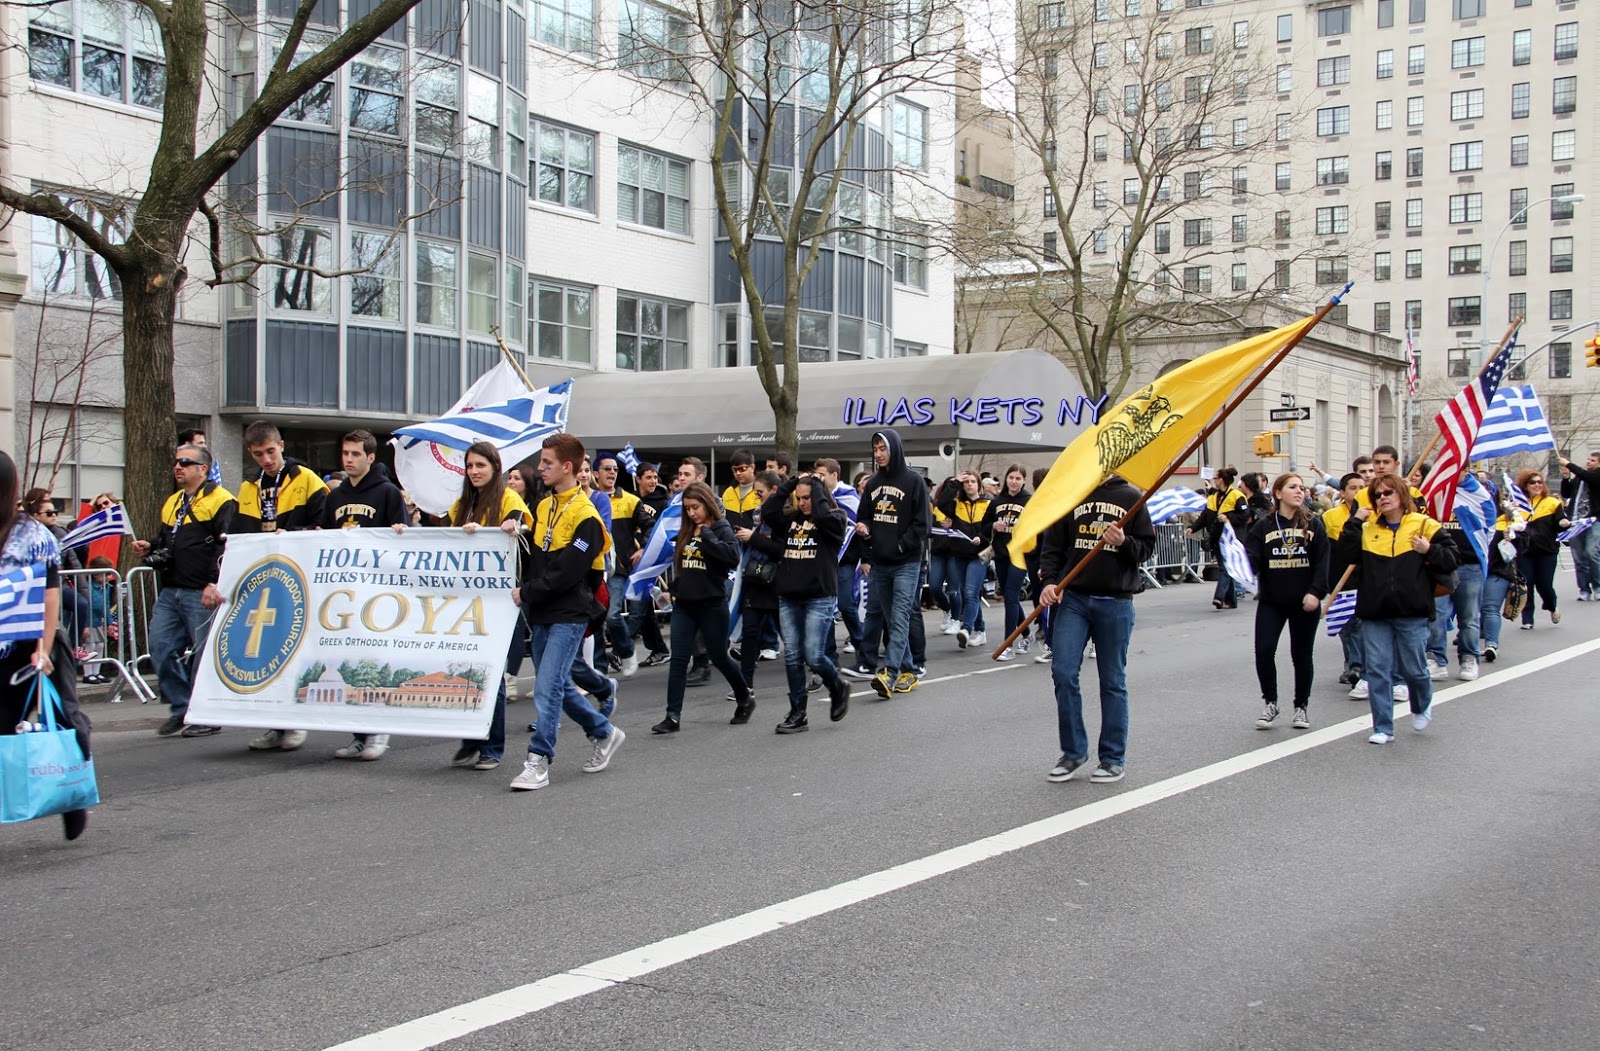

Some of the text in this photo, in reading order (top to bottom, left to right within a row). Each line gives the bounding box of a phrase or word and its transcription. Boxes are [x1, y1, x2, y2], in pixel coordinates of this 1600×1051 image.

[713, 435, 734, 443] Nine
[737, 433, 776, 443] Hundred
[806, 432, 840, 441] Avenue
[1095, 502, 1128, 519] TRINIT
[316, 547, 510, 573] HOLY TRINITY
[313, 571, 513, 590] HICKSVILLE, NEW YORK
[224, 590, 249, 631] TRINITY
[317, 589, 489, 636] GOYA
[280, 607, 304, 656] CHURCH
[319, 636, 343, 646] GREEK
[345, 637, 388, 647] ORTHODOX
[392, 639, 421, 649] YOUTH
[437, 641, 479, 652] AMERICA
[220, 631, 229, 660] HOLY
[224, 655, 281, 683] HICKSVILLE, NY
